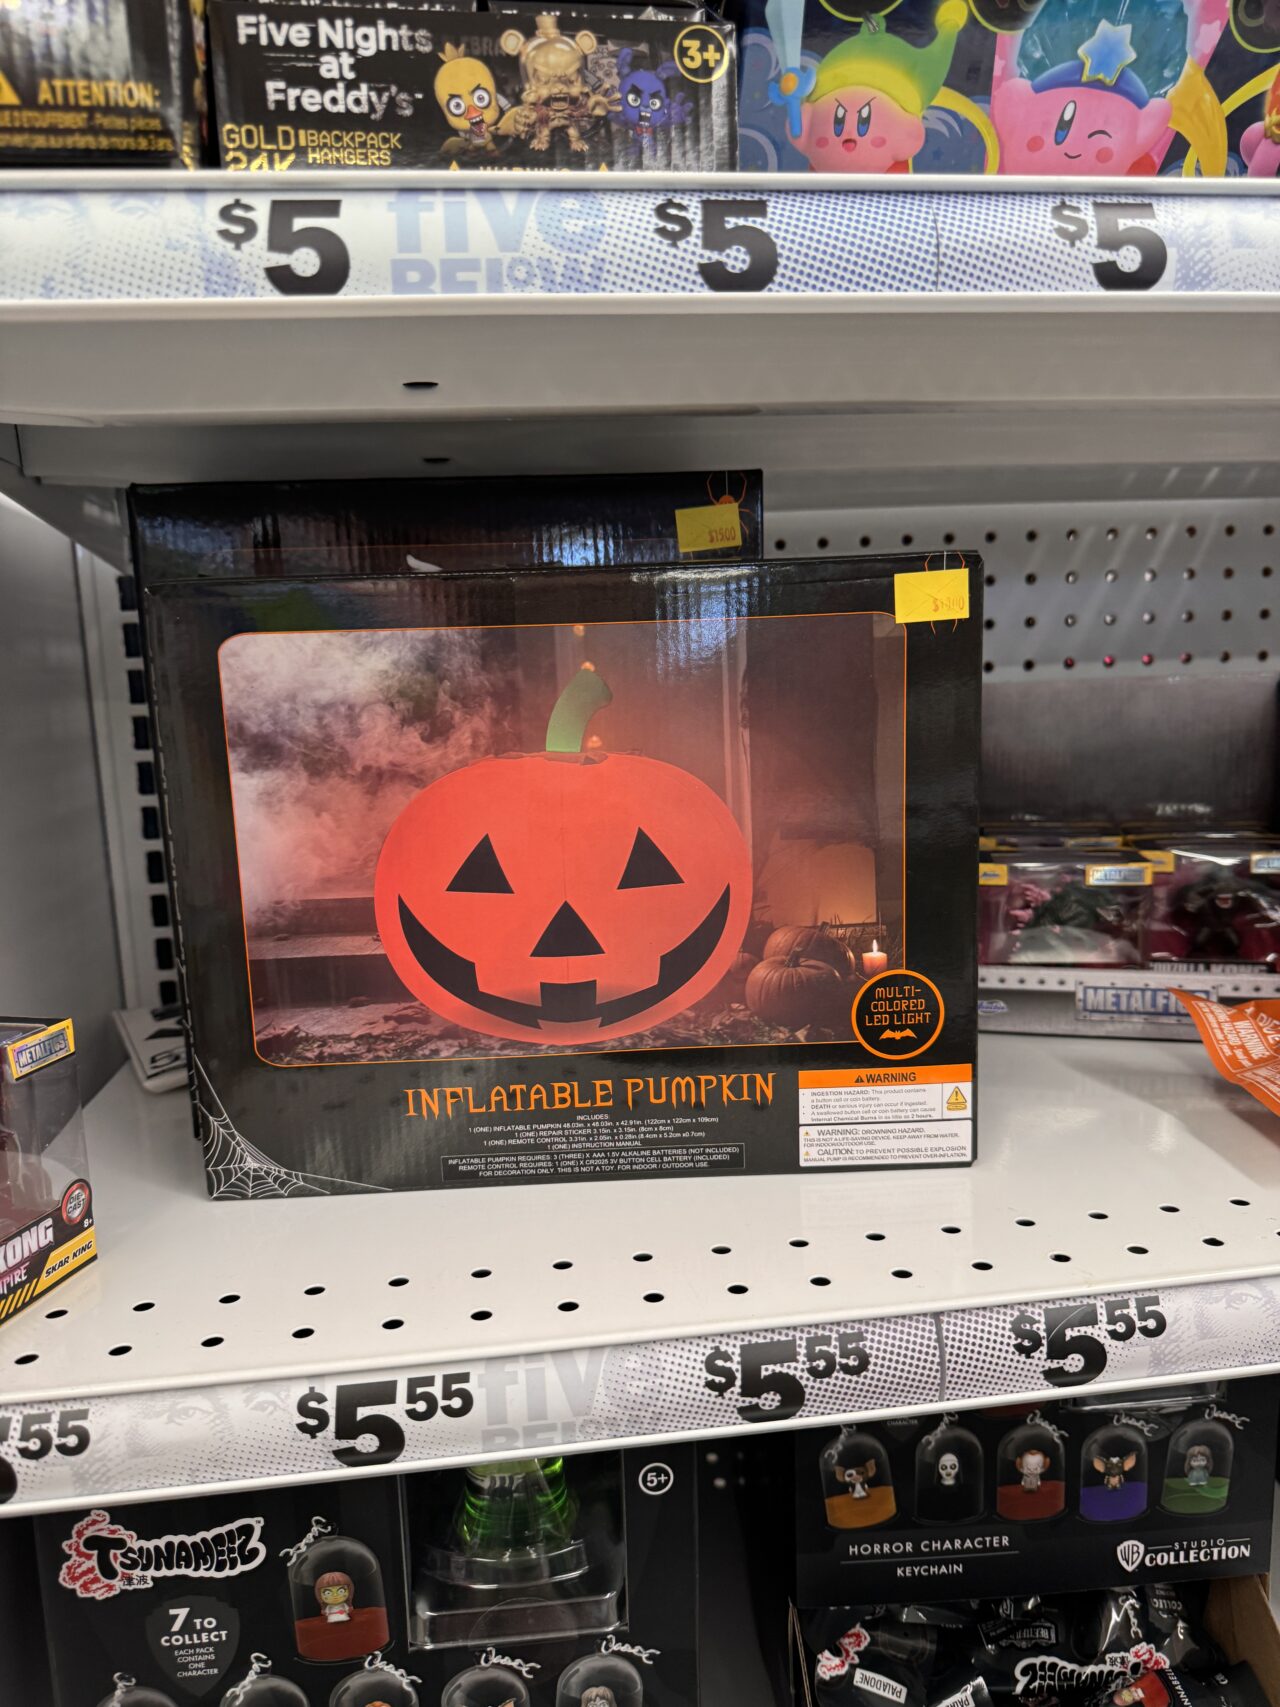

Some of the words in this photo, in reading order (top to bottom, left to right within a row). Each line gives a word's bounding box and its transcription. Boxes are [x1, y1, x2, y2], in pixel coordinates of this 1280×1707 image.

[236, 14, 311, 47] Five
[317, 18, 433, 57] Nights
[682, 39, 721, 69] 3+
[318, 52, 357, 80] at
[37, 78, 161, 108] ATTENTION:
[265, 80, 415, 121] Freddy's
[222, 123, 295, 150] GOLD
[306, 129, 403, 149] BACKPACK
[308, 148, 391, 166] HANGERS
[875, 985, 922, 999] MULTI-
[870, 999, 926, 1013] COLORED
[865, 1014, 890, 1026] LED
[893, 1012, 932, 1025] LIGHT
[865, 1072, 917, 1084] WARNING
[404, 1079, 613, 1121] INFLATABLE
[622, 1072, 776, 1112] PUMPKIN
[576, 1113, 609, 1121] INCLUDES
[493, 1124, 531, 1132] INFLATABLE
[532, 1122, 562, 1130] PUMPKIN
[817, 1128, 860, 1137] WARNING:
[572, 1141, 614, 1149] INSTRUCTION
[817, 1148, 855, 1156] CAUTION:
[448, 1157, 486, 1165] INFLATABLE
[487, 1162, 517, 1170] CONTROL
[494, 1168, 535, 1176] DECORATION
[44, 1256, 70, 1279] SKAR
[72, 1240, 93, 1260] KING
[646, 1471, 669, 1487] 5+
[848, 1541, 915, 1556] HORROR
[920, 1535, 1011, 1553] CHARACTER
[1173, 1538, 1226, 1550] STUDIO
[1144, 1543, 1252, 1568] COLLECTION
[896, 1562, 964, 1578] KEYCHAIN
[168, 1607, 191, 1632] 7
[193, 1616, 217, 1630] TO
[160, 1629, 228, 1647] COLLECT
[174, 1647, 195, 1656] EACH
[195, 1646, 215, 1655] PACK
[176, 1653, 216, 1664] CONTAINS
[176, 1667, 219, 1678] CHARACTER
[188, 1661, 206, 1670] ONE
[859, 1672, 904, 1699] PALADONE
